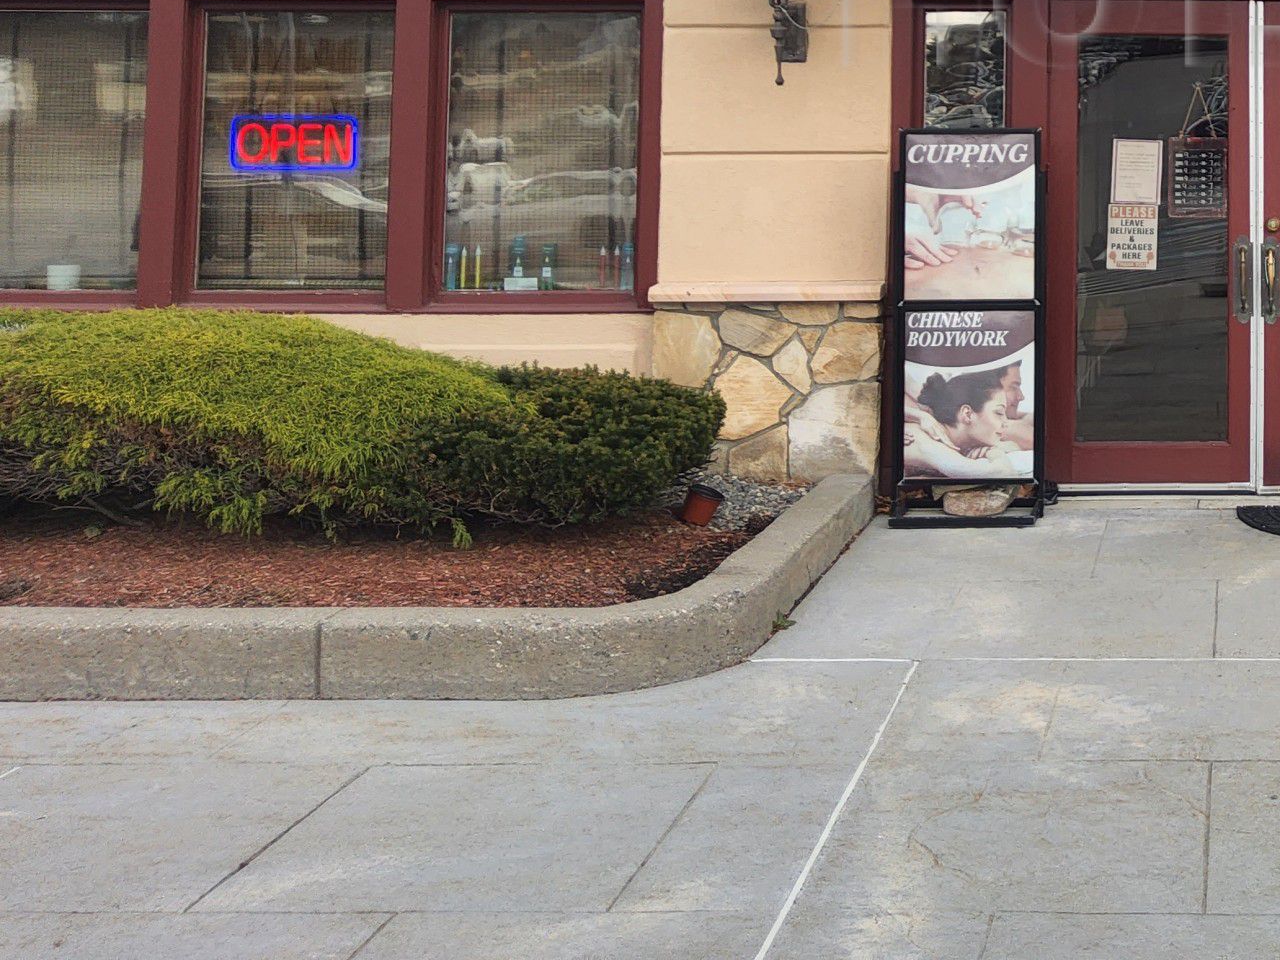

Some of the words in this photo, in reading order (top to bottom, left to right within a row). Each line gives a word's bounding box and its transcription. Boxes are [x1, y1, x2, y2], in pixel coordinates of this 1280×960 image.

[237, 122, 352, 164] OPEN
[907, 142, 1029, 165] CUPPING
[1111, 206, 1154, 218] PLEASE
[1120, 219, 1145, 227] LEAVE
[1110, 227, 1155, 235] DELIVERIES
[1111, 243, 1153, 251] PACKAGES
[1122, 252, 1142, 260] HERE
[907, 310, 984, 329] CHINESE
[906, 330, 1009, 348] BODYWORK
